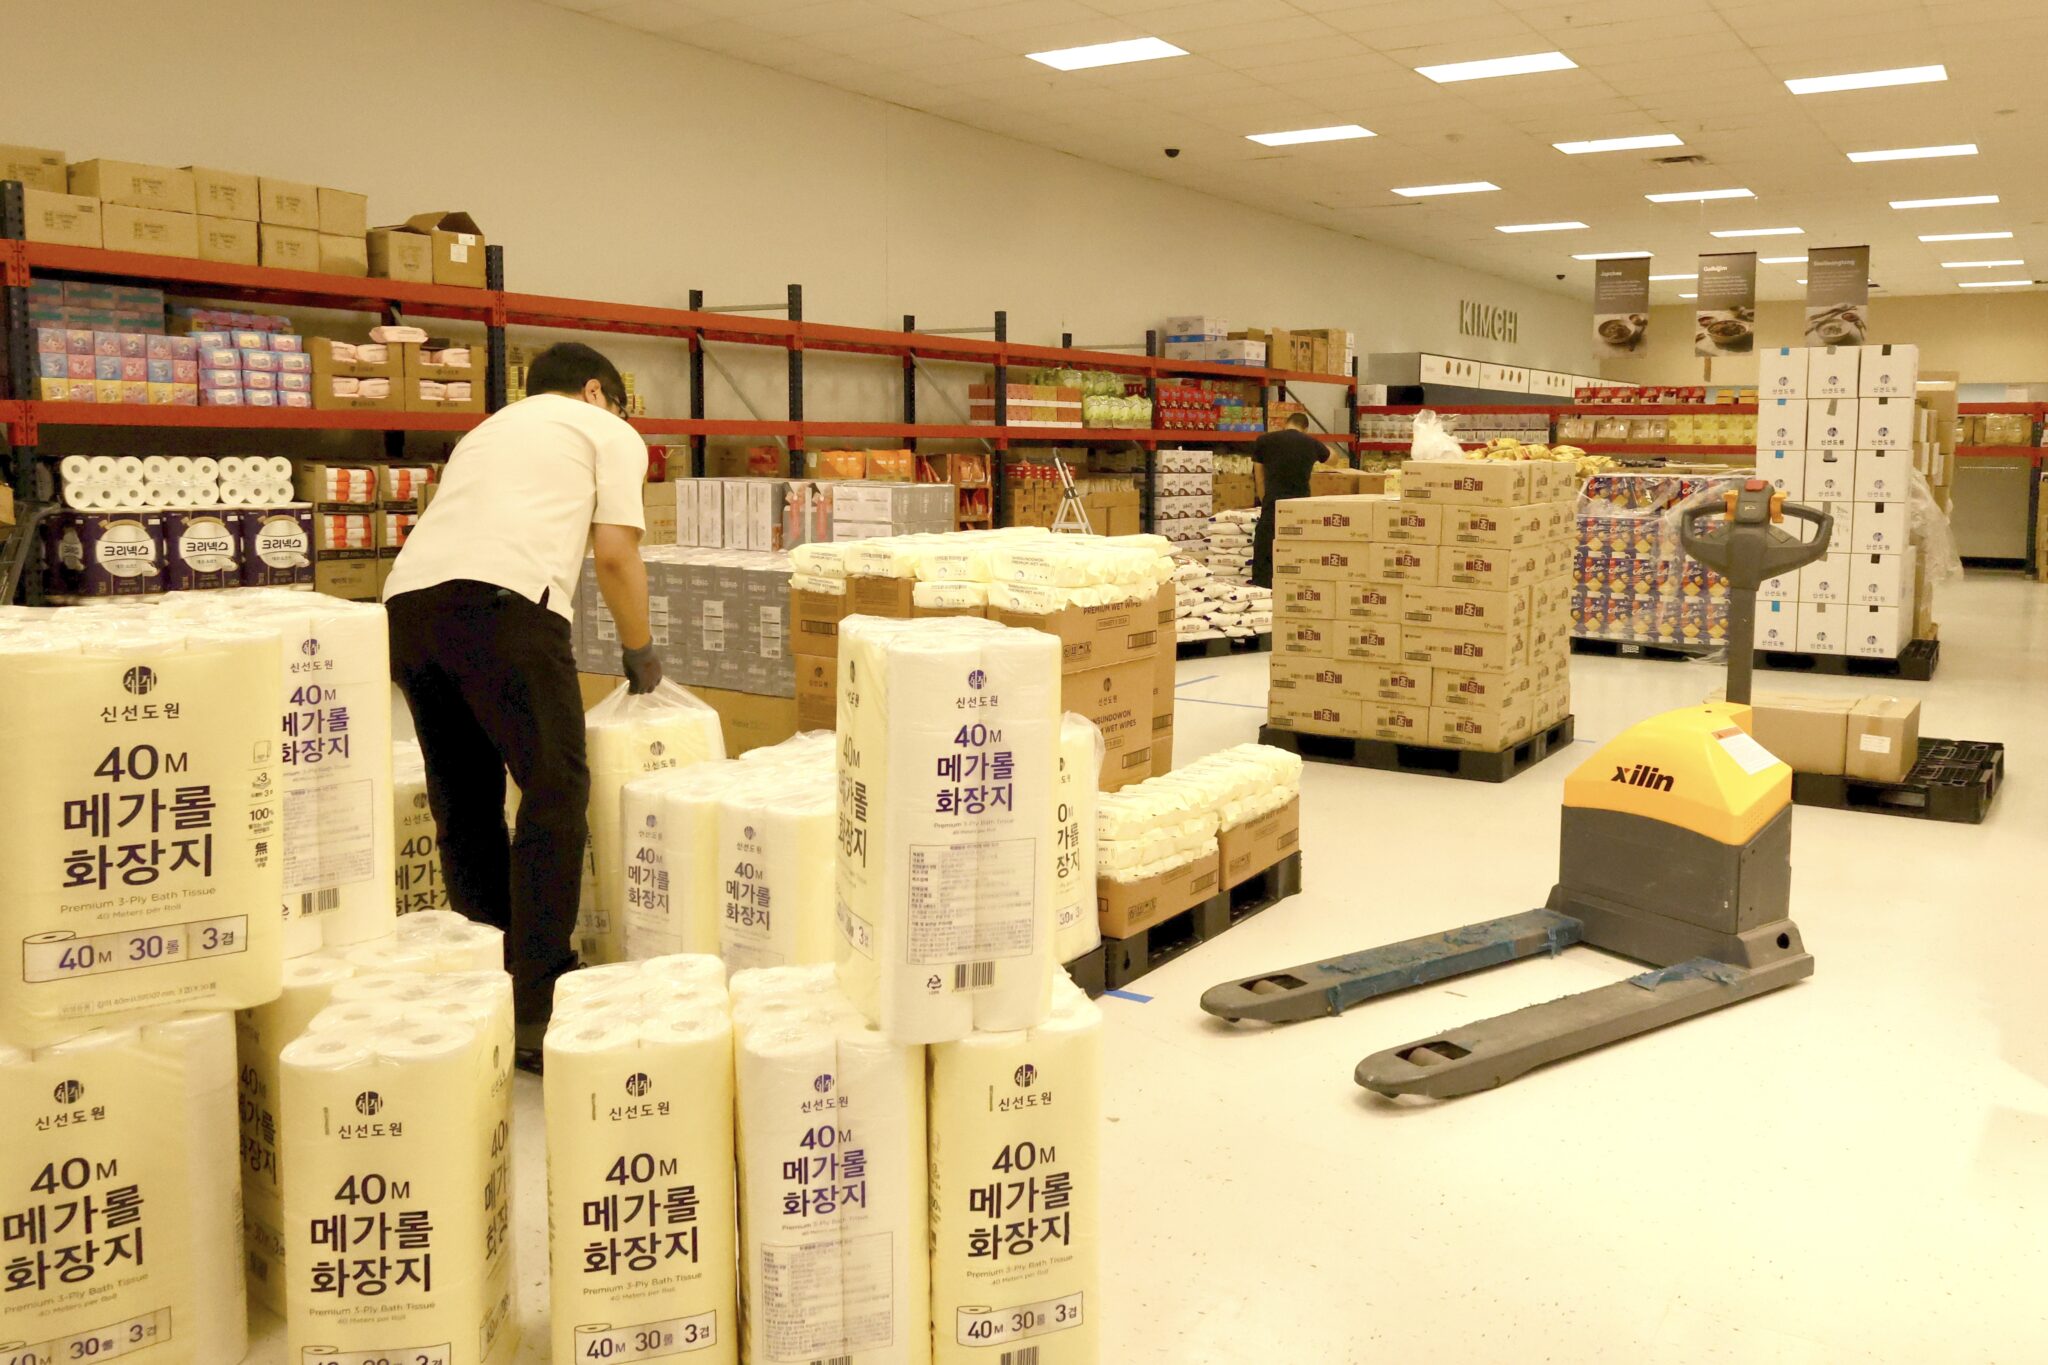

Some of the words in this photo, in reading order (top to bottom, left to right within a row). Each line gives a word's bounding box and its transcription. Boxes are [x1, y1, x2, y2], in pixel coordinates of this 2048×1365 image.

[104, 545, 149, 557] 크리넥스
[186, 541, 229, 553] 크리넥스
[262, 539, 302, 550] 크리넥스
[1083, 604, 1111, 616] PREMIUM
[1112, 602, 1124, 611] WET
[290, 658, 334, 674] 신선도원
[289, 684, 337, 707] 40M
[956, 695, 999, 710] 신선도원
[100, 702, 181, 724] 신선도원
[1105, 723, 1118, 734] WET
[1120, 719, 1137, 730] WIPES
[954, 723, 1002, 748] 40M
[93, 743, 189, 783] 40M
[643, 758, 677, 773] 신선도원
[937, 750, 1016, 783] 메가롤
[1610, 764, 1675, 793] xilin
[63, 783, 217, 838] 메가롤
[936, 783, 1014, 817] 화장지
[400, 835, 438, 859] 40
[636, 847, 664, 865] 40M
[62, 833, 213, 890] 화장지
[734, 862, 764, 882] 40M
[628, 865, 671, 892] 메가롤
[60, 901, 114, 914] Premium
[152, 891, 178, 902] Bath
[182, 888, 217, 898] Tissue
[628, 888, 671, 914] 화장지
[726, 880, 771, 909] 메가롤
[726, 902, 771, 932] 화장지
[58, 945, 112, 970] 40M
[608, 1101, 671, 1122] 신선도원
[801, 1096, 850, 1114] 신선도원
[998, 1090, 1053, 1113] 신선도원
[35, 1105, 107, 1132] 신선도원
[338, 1122, 404, 1140] 신선도원
[799, 1124, 853, 1151] 40M
[605, 1152, 678, 1186] 40M
[783, 1148, 868, 1186] 메가롤
[992, 1140, 1056, 1175] 40M
[30, 1157, 118, 1195] 40M
[334, 1173, 412, 1206] 40M
[583, 1184, 701, 1233] 메가롤
[783, 1180, 867, 1218] 화장지
[969, 1171, 1074, 1220] 메가롤
[2, 1184, 145, 1247] 메가롤
[310, 1210, 434, 1253] 메가롤
[968, 1210, 1071, 1261] 화장지
[4, 1226, 144, 1294] 화장지
[583, 1226, 699, 1276] 화장지
[310, 1253, 432, 1298] 화장지
[583, 1284, 624, 1296] Premium
[968, 1320, 1004, 1339] 40M
[586, 1338, 626, 1359] 40M
